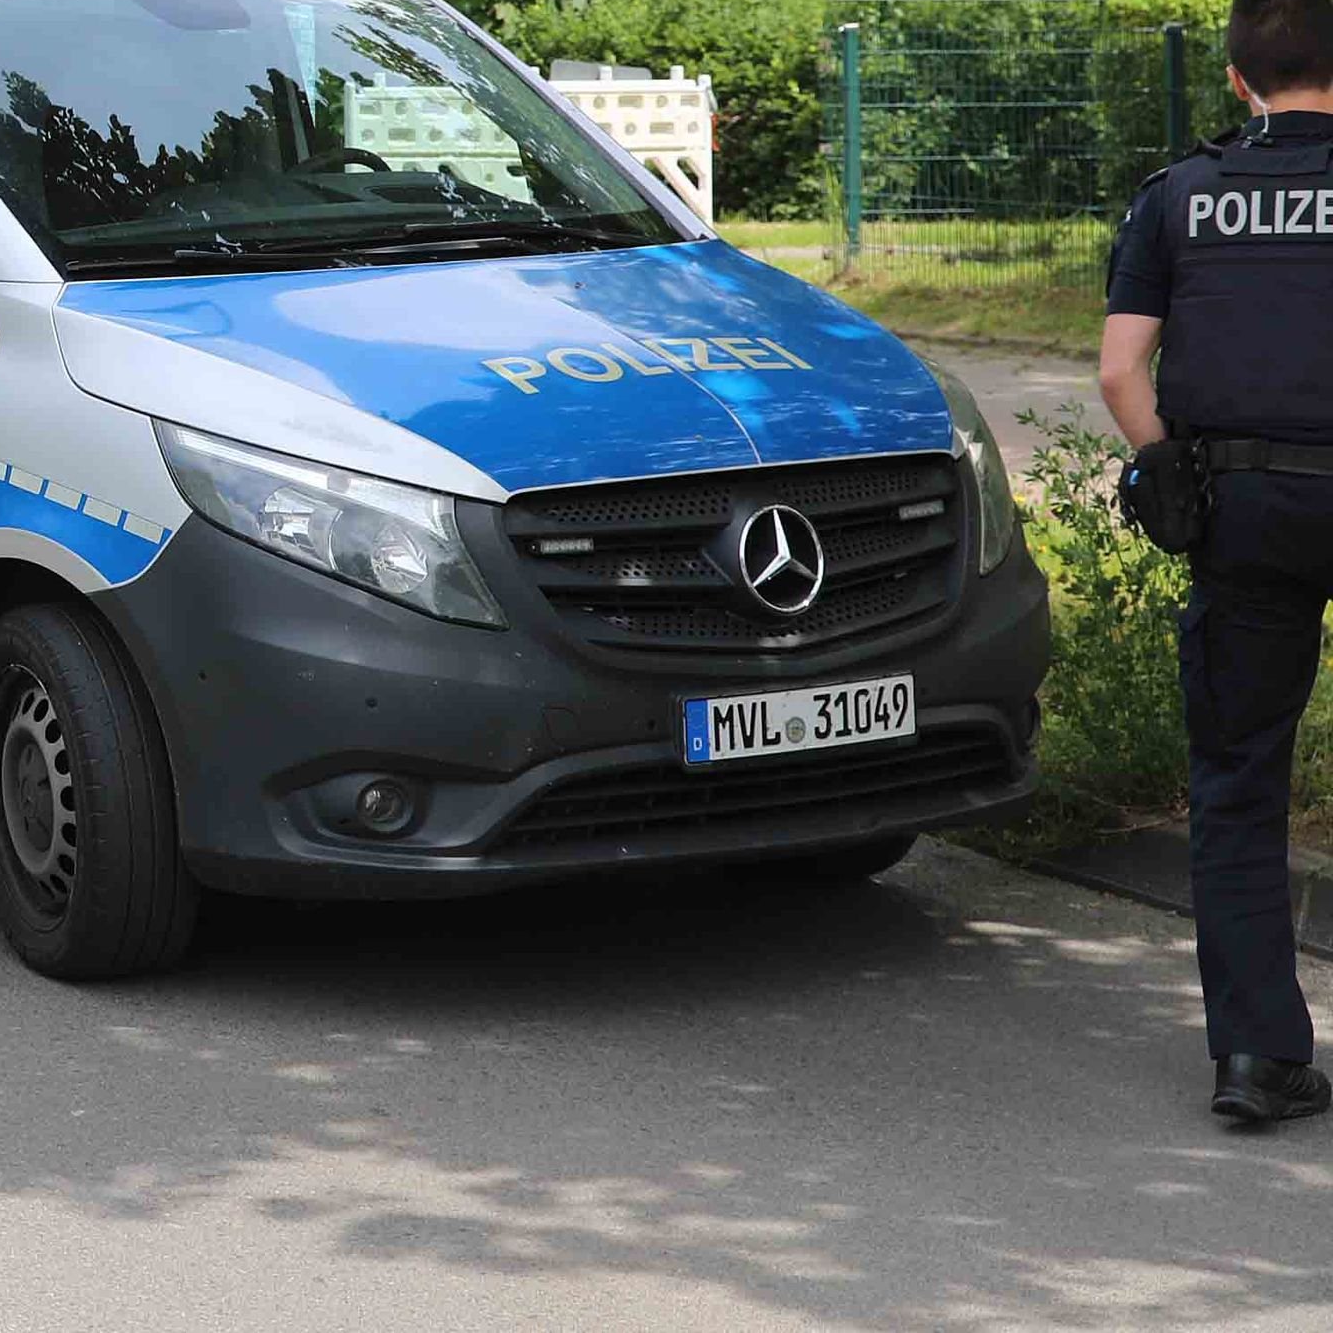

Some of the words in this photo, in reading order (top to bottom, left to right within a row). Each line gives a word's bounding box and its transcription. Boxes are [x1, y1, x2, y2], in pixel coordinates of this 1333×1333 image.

[1188, 189, 1333, 238] POLIZE
[481, 337, 813, 395] POLIZEI
[713, 701, 781, 752] MVL
[813, 682, 909, 740] 31049
